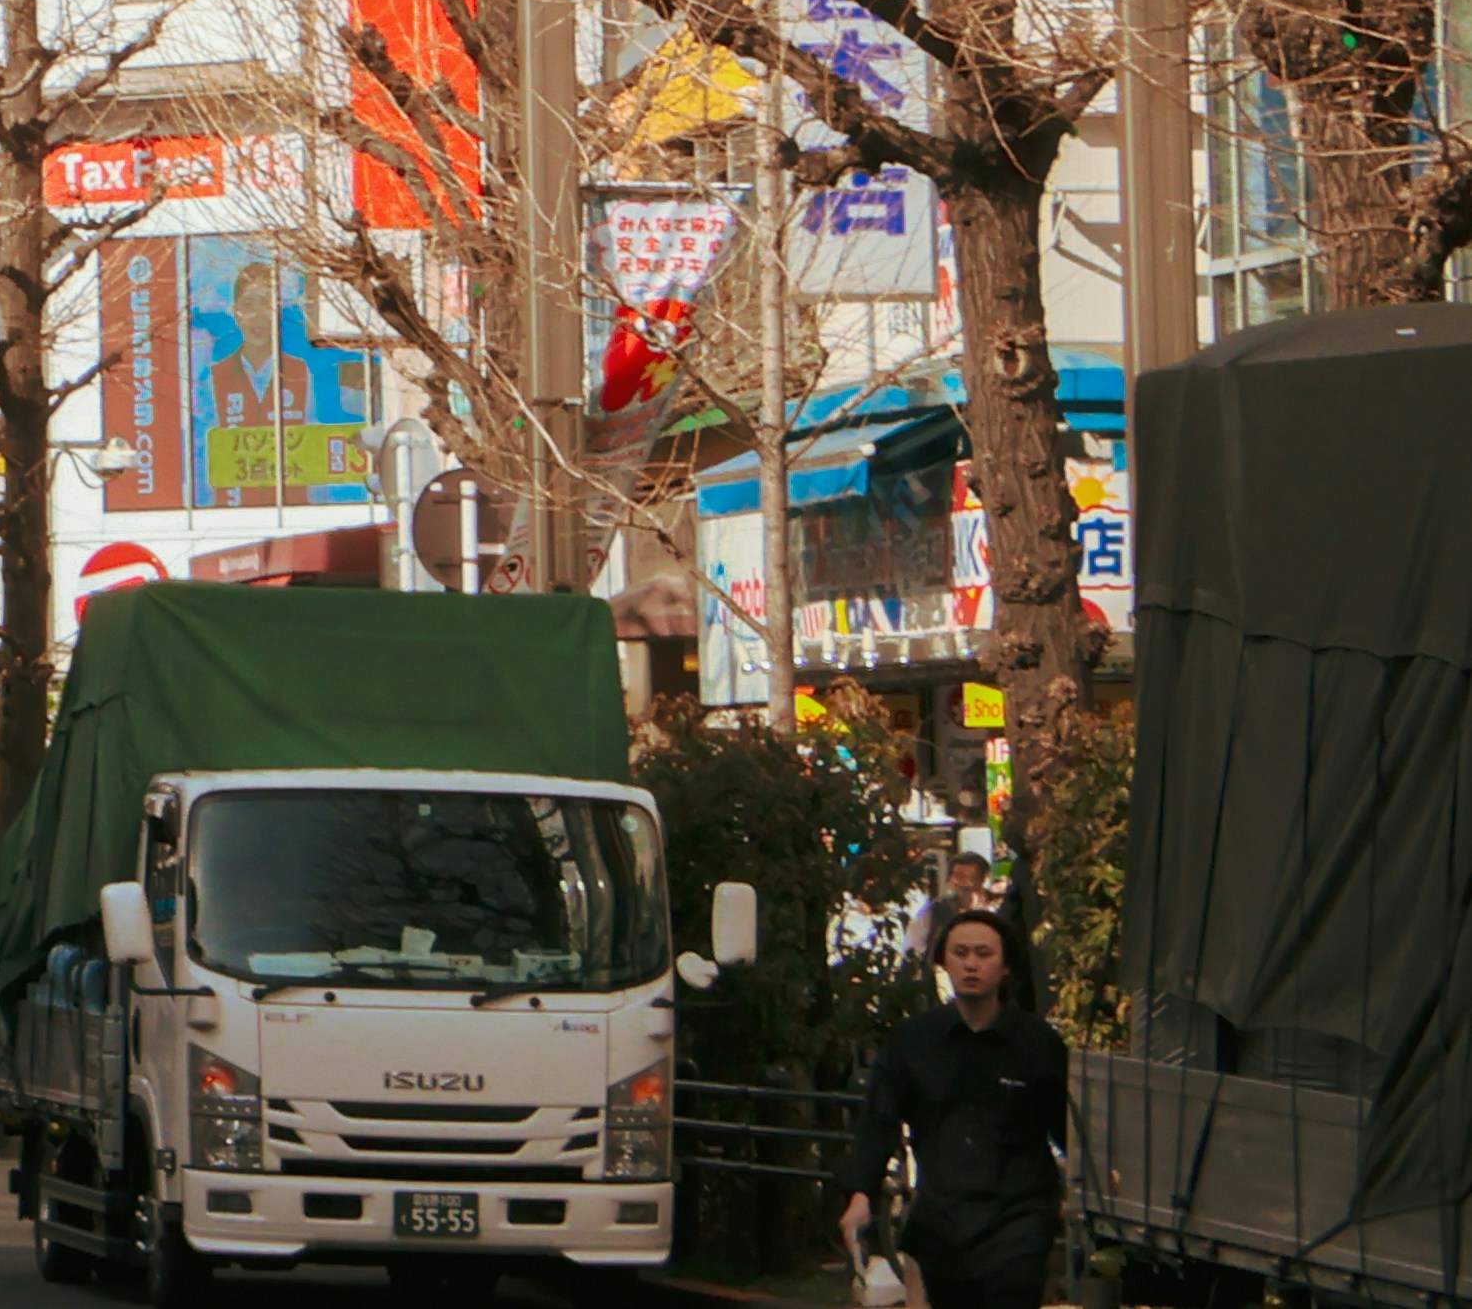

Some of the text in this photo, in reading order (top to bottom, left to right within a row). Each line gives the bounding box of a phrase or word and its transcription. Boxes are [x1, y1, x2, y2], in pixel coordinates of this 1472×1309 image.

[56, 151, 128, 193] Tax
[383, 1071, 485, 1093] ISUZU
[410, 1208, 476, 1233] 55-55
